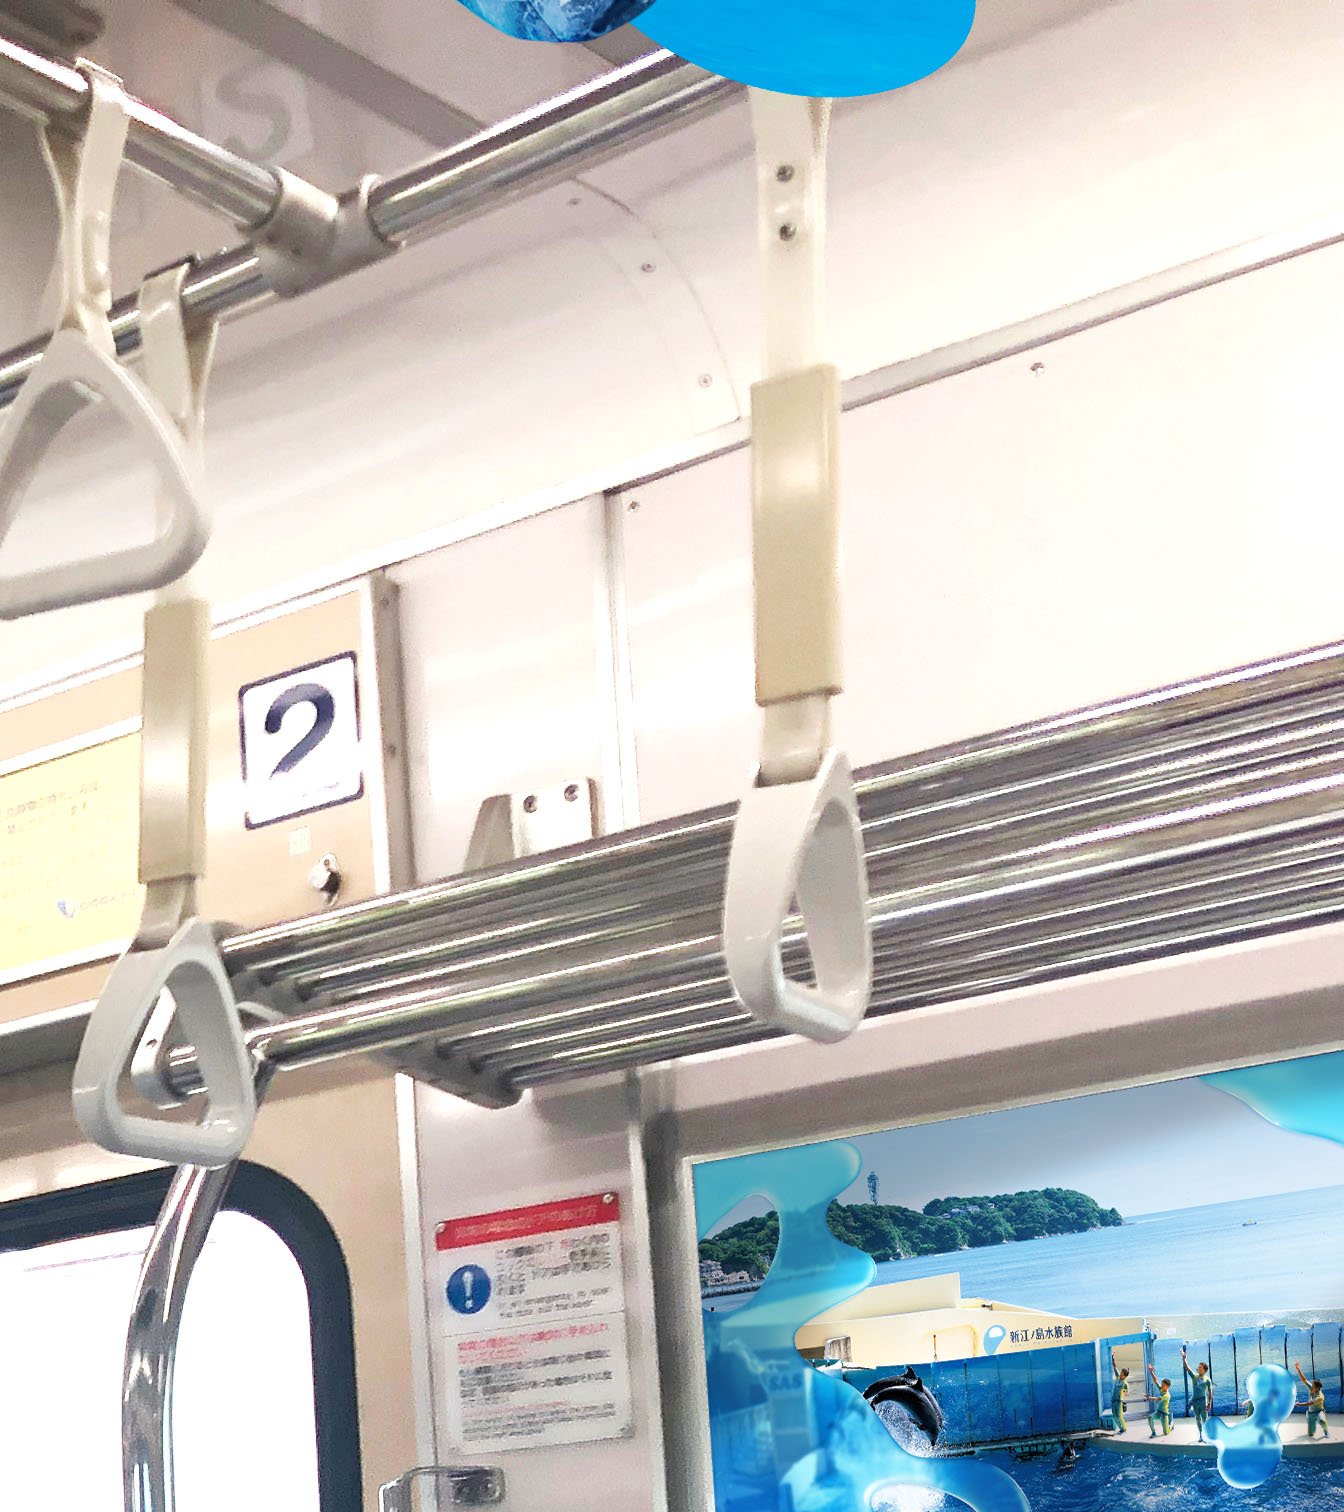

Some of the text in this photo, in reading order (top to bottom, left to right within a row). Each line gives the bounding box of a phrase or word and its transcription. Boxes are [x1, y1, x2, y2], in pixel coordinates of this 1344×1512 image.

[264, 683, 335, 781] 2
[1009, 1325, 1073, 1344] 新江ノ島水族館
